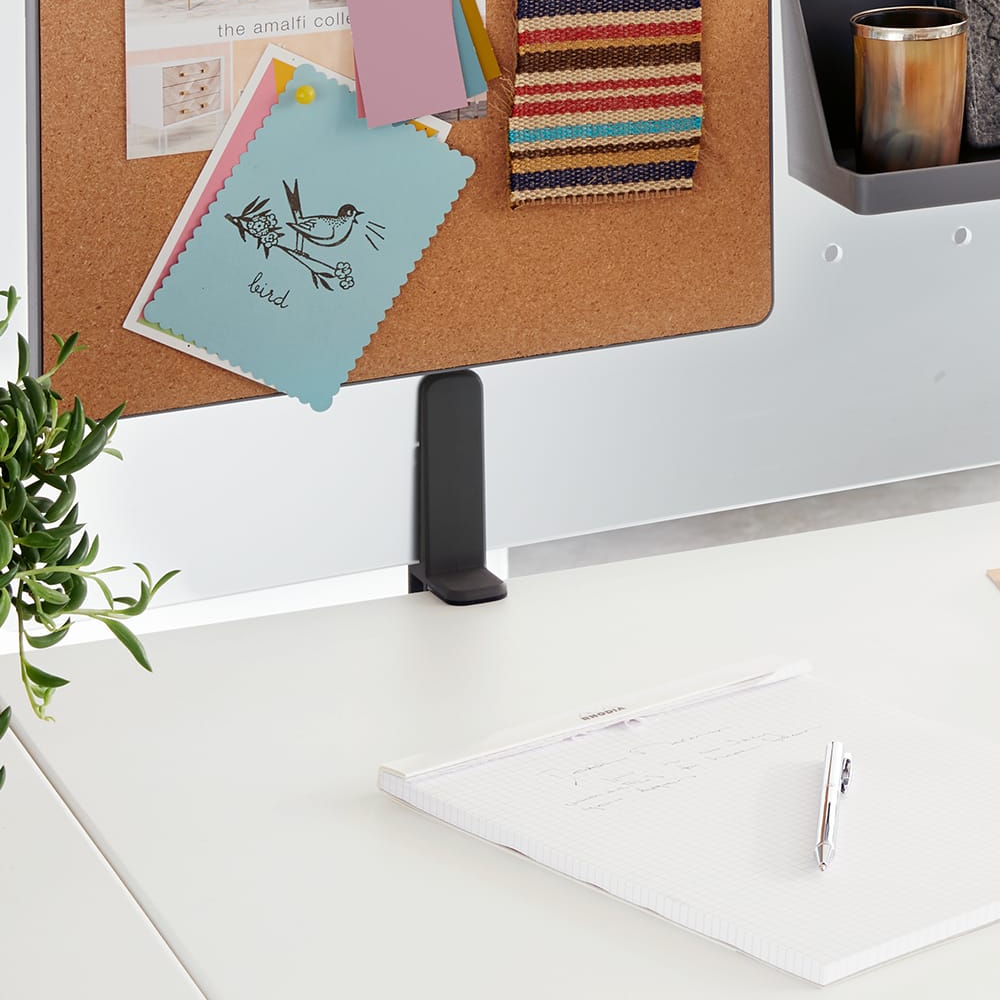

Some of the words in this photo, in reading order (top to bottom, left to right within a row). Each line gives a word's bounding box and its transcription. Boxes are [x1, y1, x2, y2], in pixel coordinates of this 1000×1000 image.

[217, 23, 248, 39] the
[253, 15, 307, 34] amalfi
[248, 271, 291, 309] bird
[580, 706, 626, 721] RHODIA
